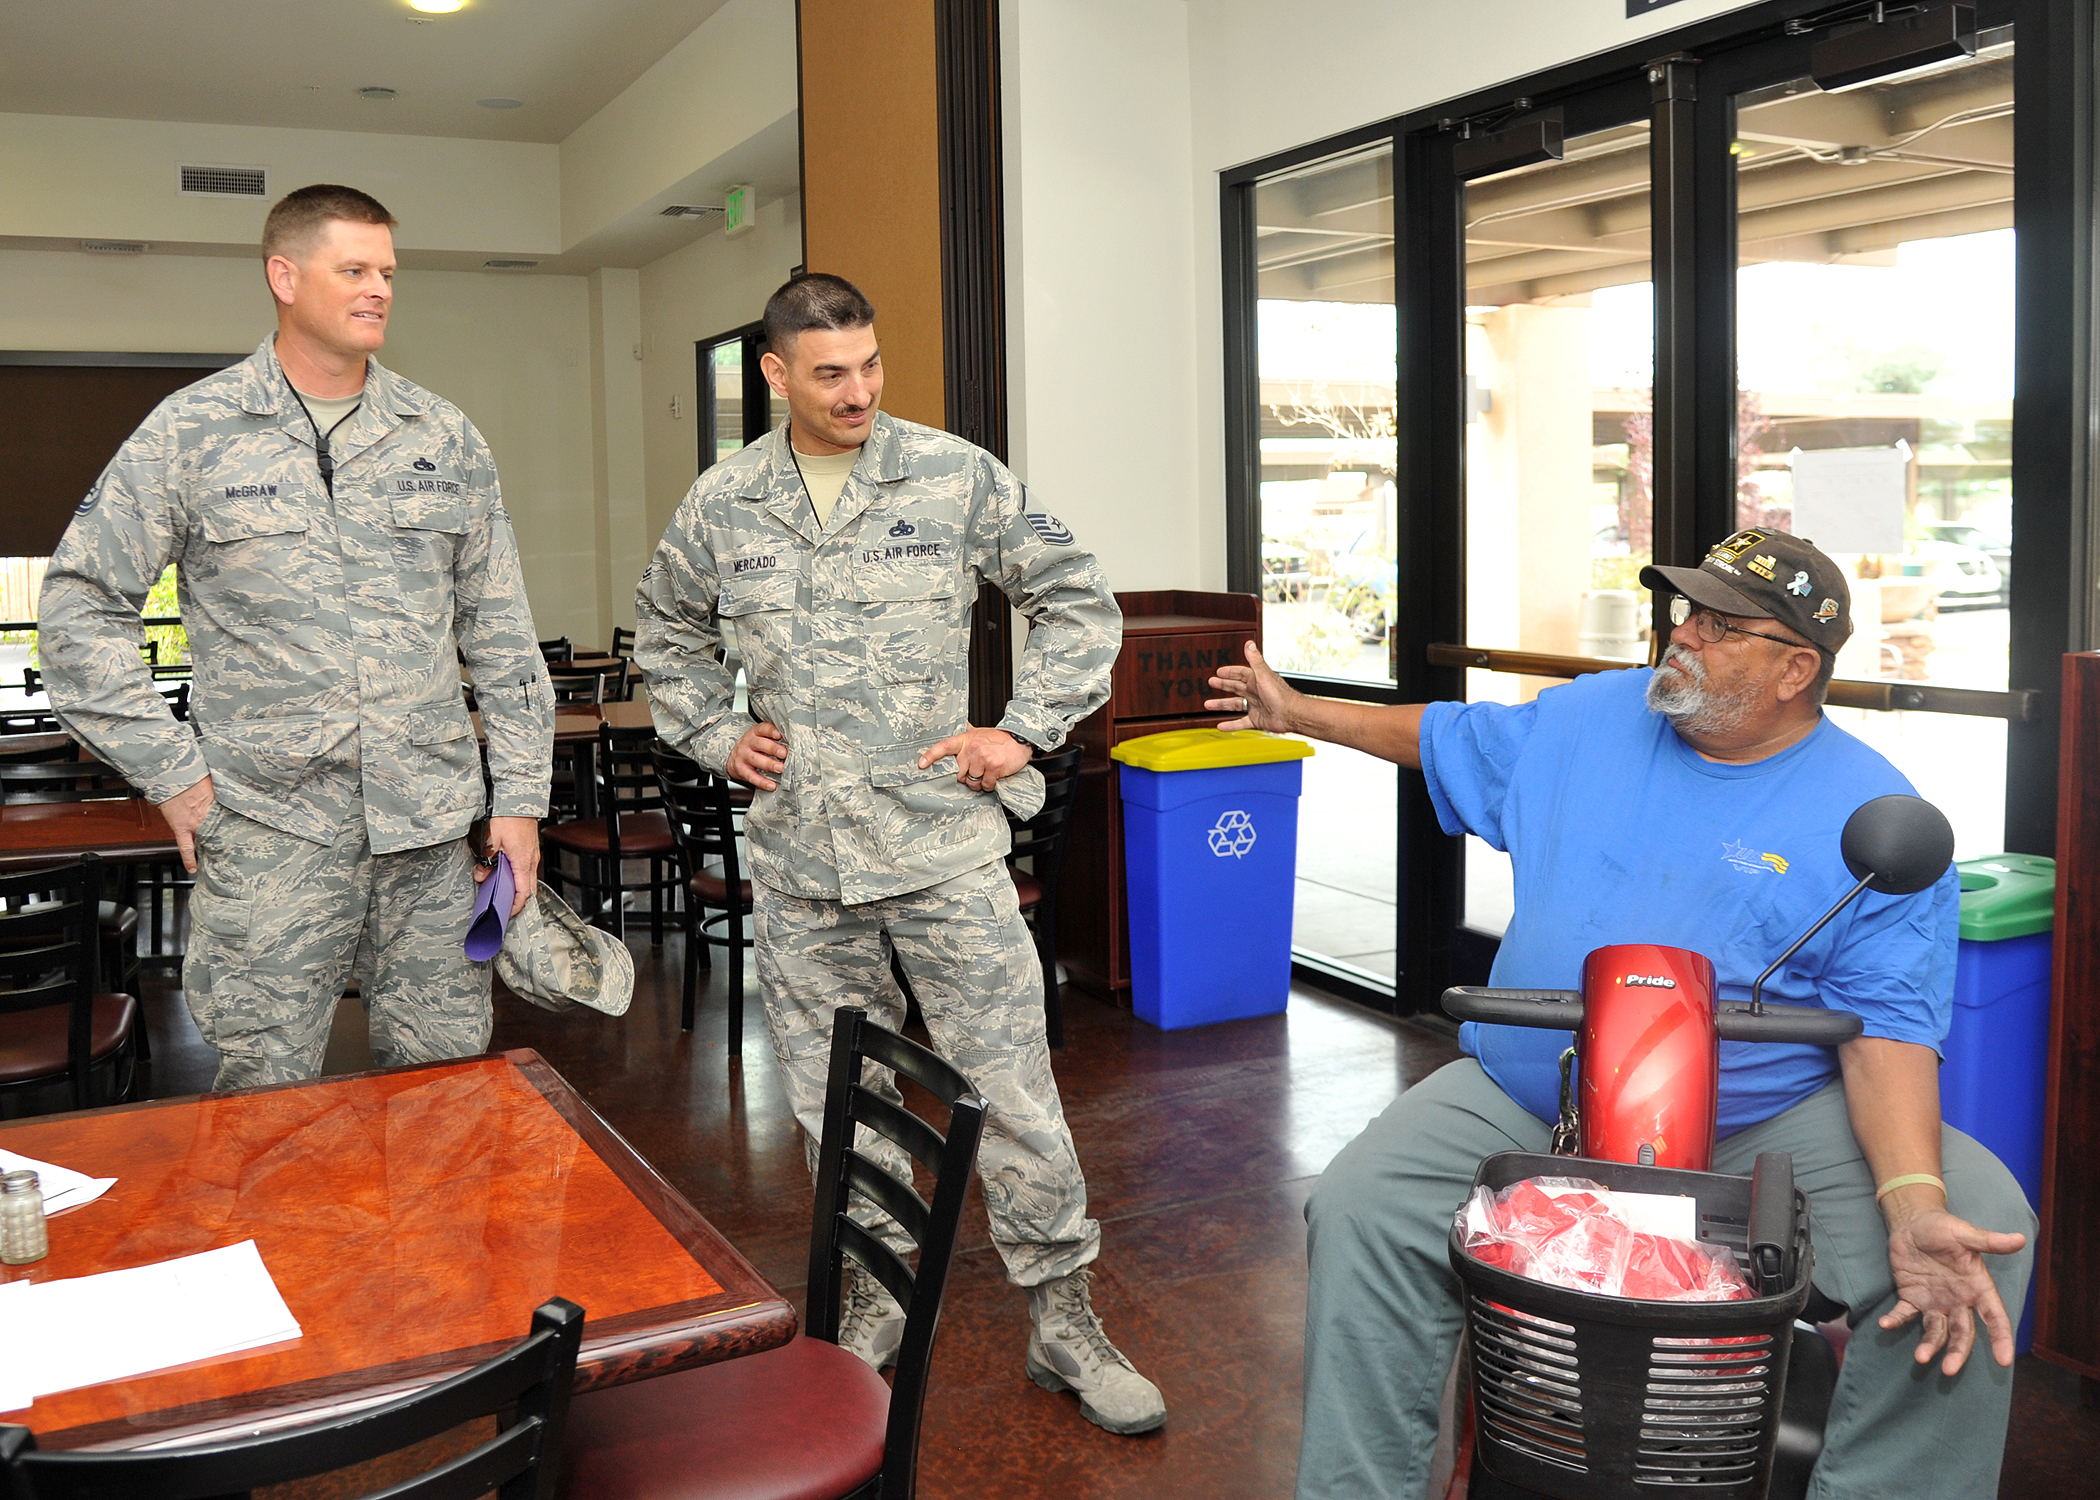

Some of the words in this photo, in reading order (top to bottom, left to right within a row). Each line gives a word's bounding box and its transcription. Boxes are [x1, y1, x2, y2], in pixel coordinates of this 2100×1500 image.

[225, 485, 277, 499] McGRAW
[397, 480, 417, 492] U.S.
[418, 481, 435, 493] AIR
[438, 482, 460, 495] FORCE
[863, 551, 883, 564] U.S.
[885, 548, 903, 560] AIR
[907, 543, 941, 557] FORCE
[733, 555, 776, 573] MERCADO
[1137, 648, 1232, 672] THANK
[1160, 677, 1214, 698] YOU
[1625, 974, 1676, 989] Pride
